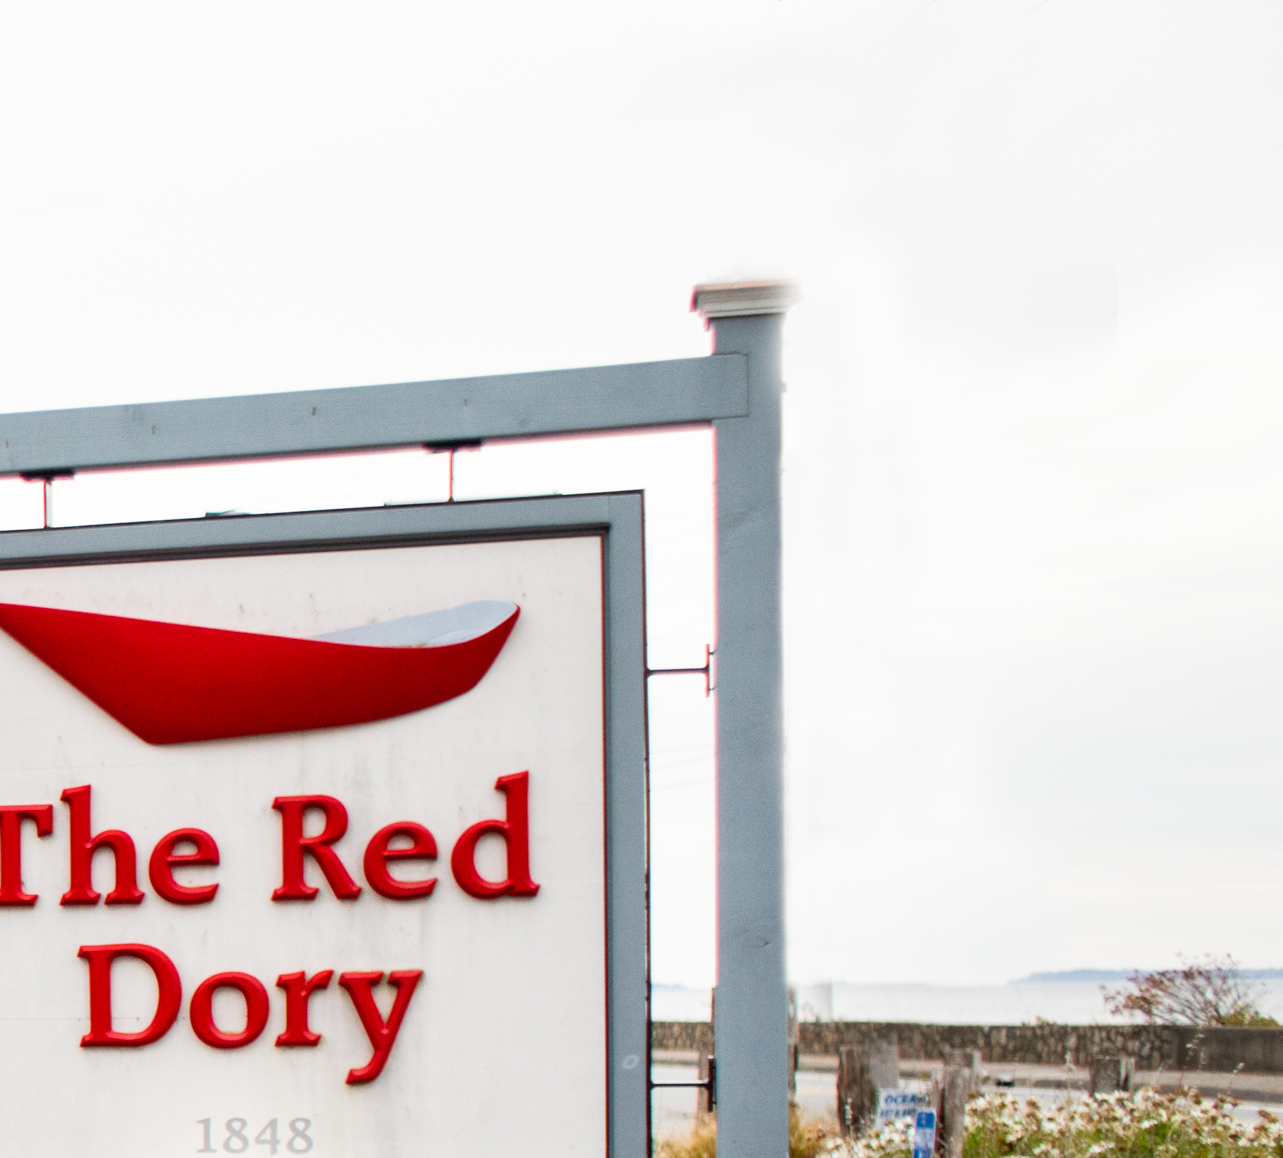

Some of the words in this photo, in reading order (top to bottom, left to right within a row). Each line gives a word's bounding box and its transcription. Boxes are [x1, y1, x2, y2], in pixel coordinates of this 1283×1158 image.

[271, 770, 541, 903] Red
[77, 943, 423, 1086] Dory
[195, 1117, 314, 1156] 1848
